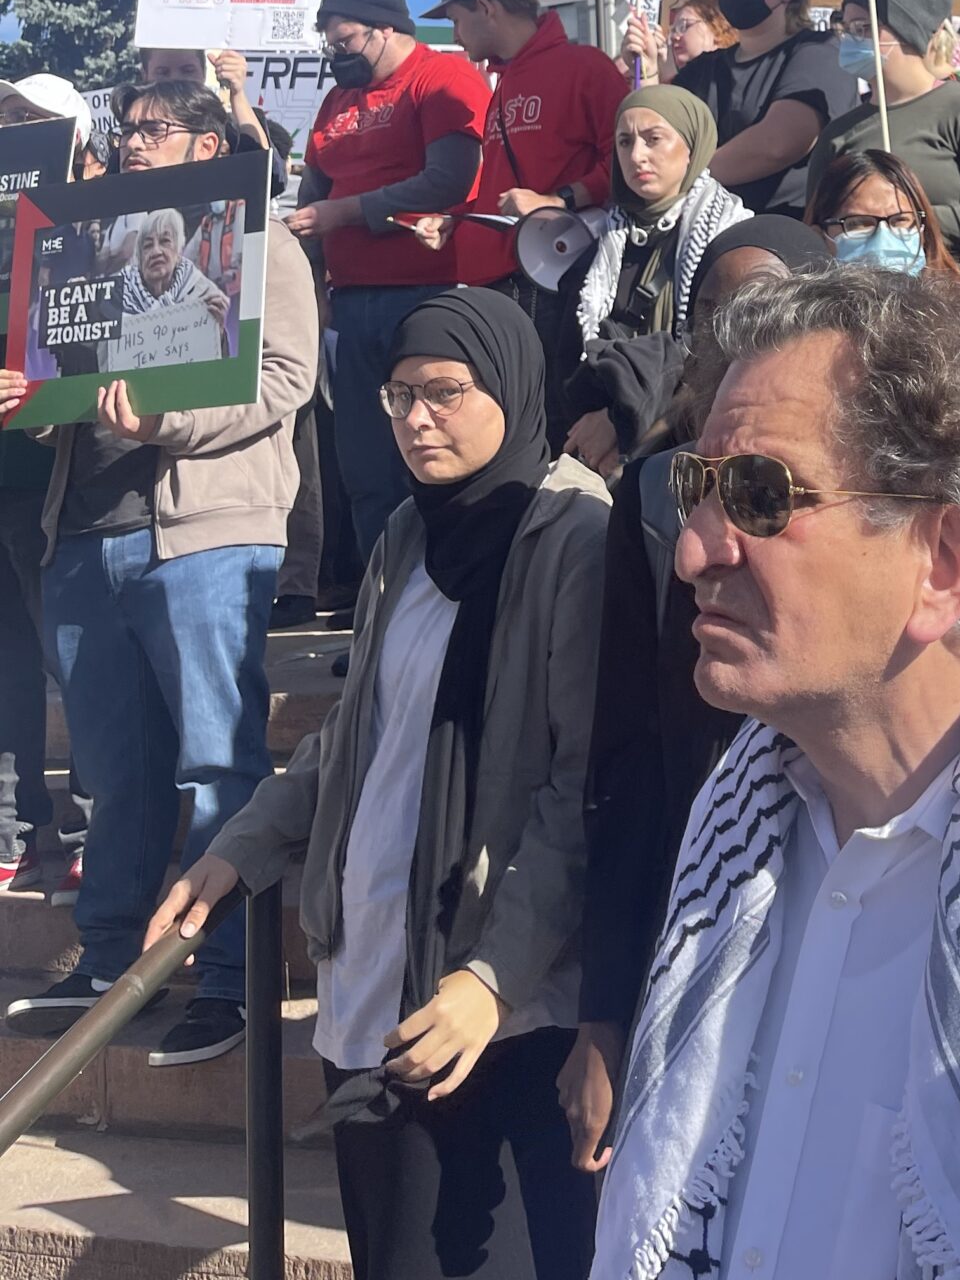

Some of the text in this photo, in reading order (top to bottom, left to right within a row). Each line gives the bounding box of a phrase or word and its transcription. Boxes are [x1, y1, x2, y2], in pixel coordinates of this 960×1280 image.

[60, 280, 115, 306] CAN'T
[47, 304, 88, 327] BE A
[116, 331, 144, 354] THIS
[153, 325, 168, 341] 90
[193, 314, 208, 328] old
